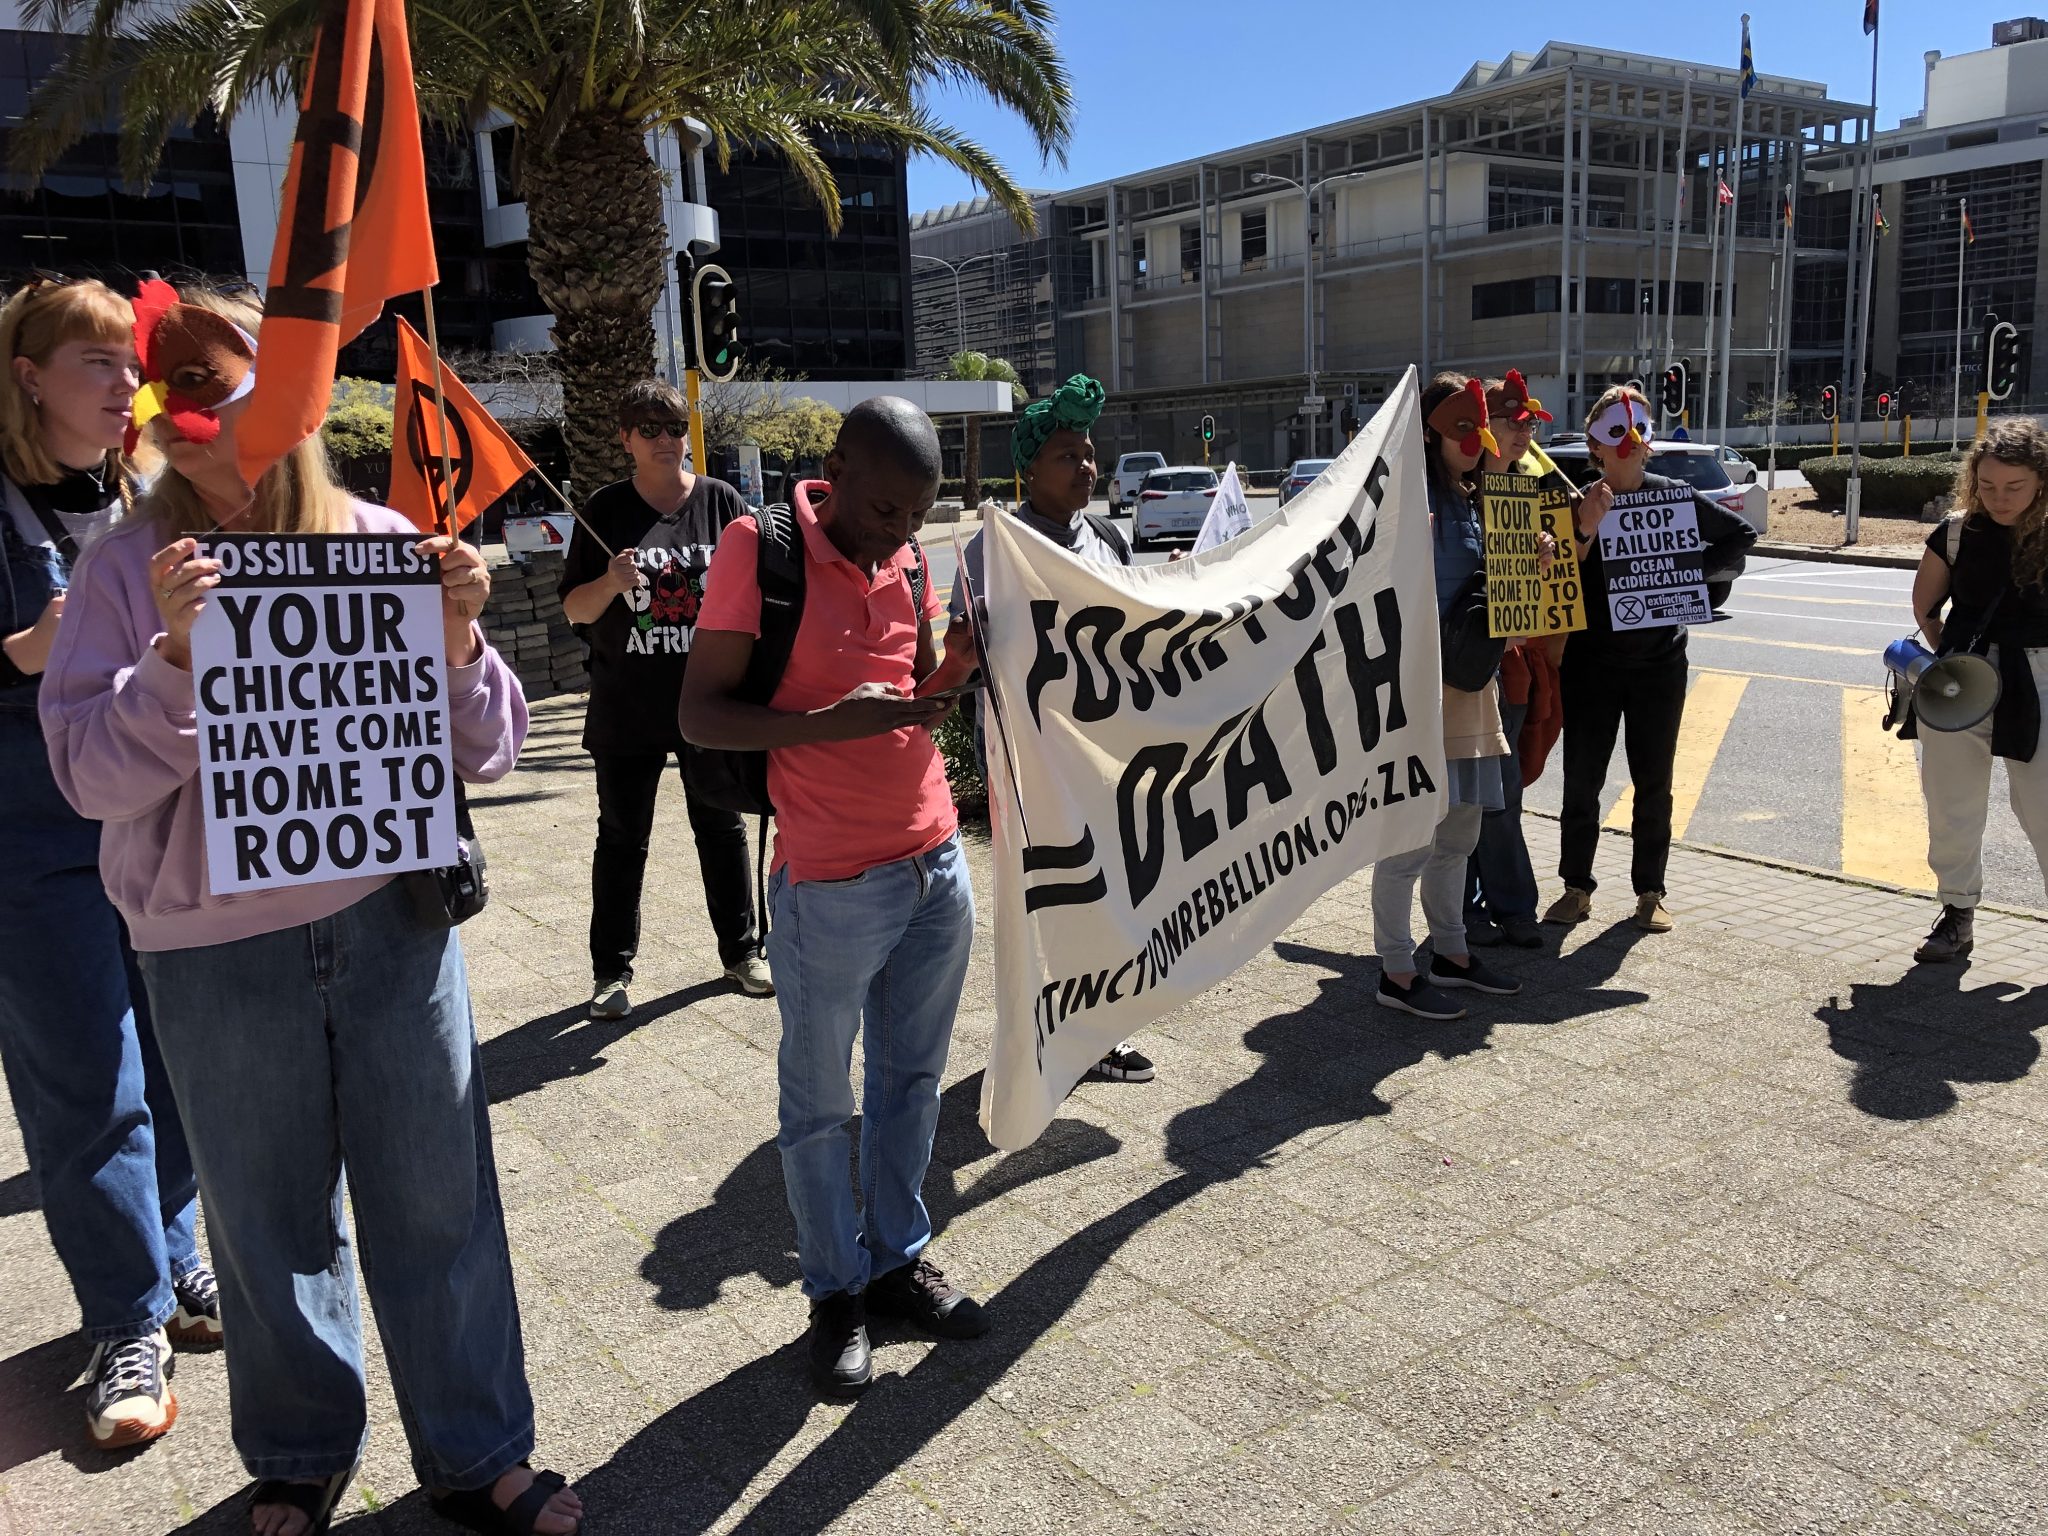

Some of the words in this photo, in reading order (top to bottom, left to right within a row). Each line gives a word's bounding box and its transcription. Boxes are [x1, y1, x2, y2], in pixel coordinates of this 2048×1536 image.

[1485, 475, 1511, 491] FOSSIL
[1513, 476, 1537, 494] FUELS:
[1540, 489, 1566, 506] ELS:
[1226, 503, 1247, 518] WHO
[1490, 499, 1532, 530] YOUR
[1619, 508, 1675, 532] CROP
[1487, 532, 1539, 555] CHICKENS
[1602, 528, 1699, 558] FAILURES
[326, 541, 431, 575] FUELS:
[1489, 559, 1512, 576] HAVE
[1515, 558, 1540, 576] COME
[1630, 557, 1675, 574] OCEAN
[1490, 580, 1521, 602] HOME
[1526, 579, 1541, 601] TO
[1549, 581, 1578, 602] TO
[1609, 569, 1704, 591] ACIDIFICATION
[1648, 593, 1693, 606] extinction
[1663, 602, 1705, 617] rebellion
[217, 593, 408, 659] YOUR
[1494, 604, 1538, 632] ROOST
[626, 626, 696, 655] AFRI
[200, 656, 438, 716] CHICKENS
[208, 718, 320, 762] HAVE
[336, 710, 443, 752] COME
[1117, 587, 1408, 909] DEATH
[212, 760, 363, 819] HOME
[381, 754, 445, 802] TO
[234, 807, 434, 881] ROOST
